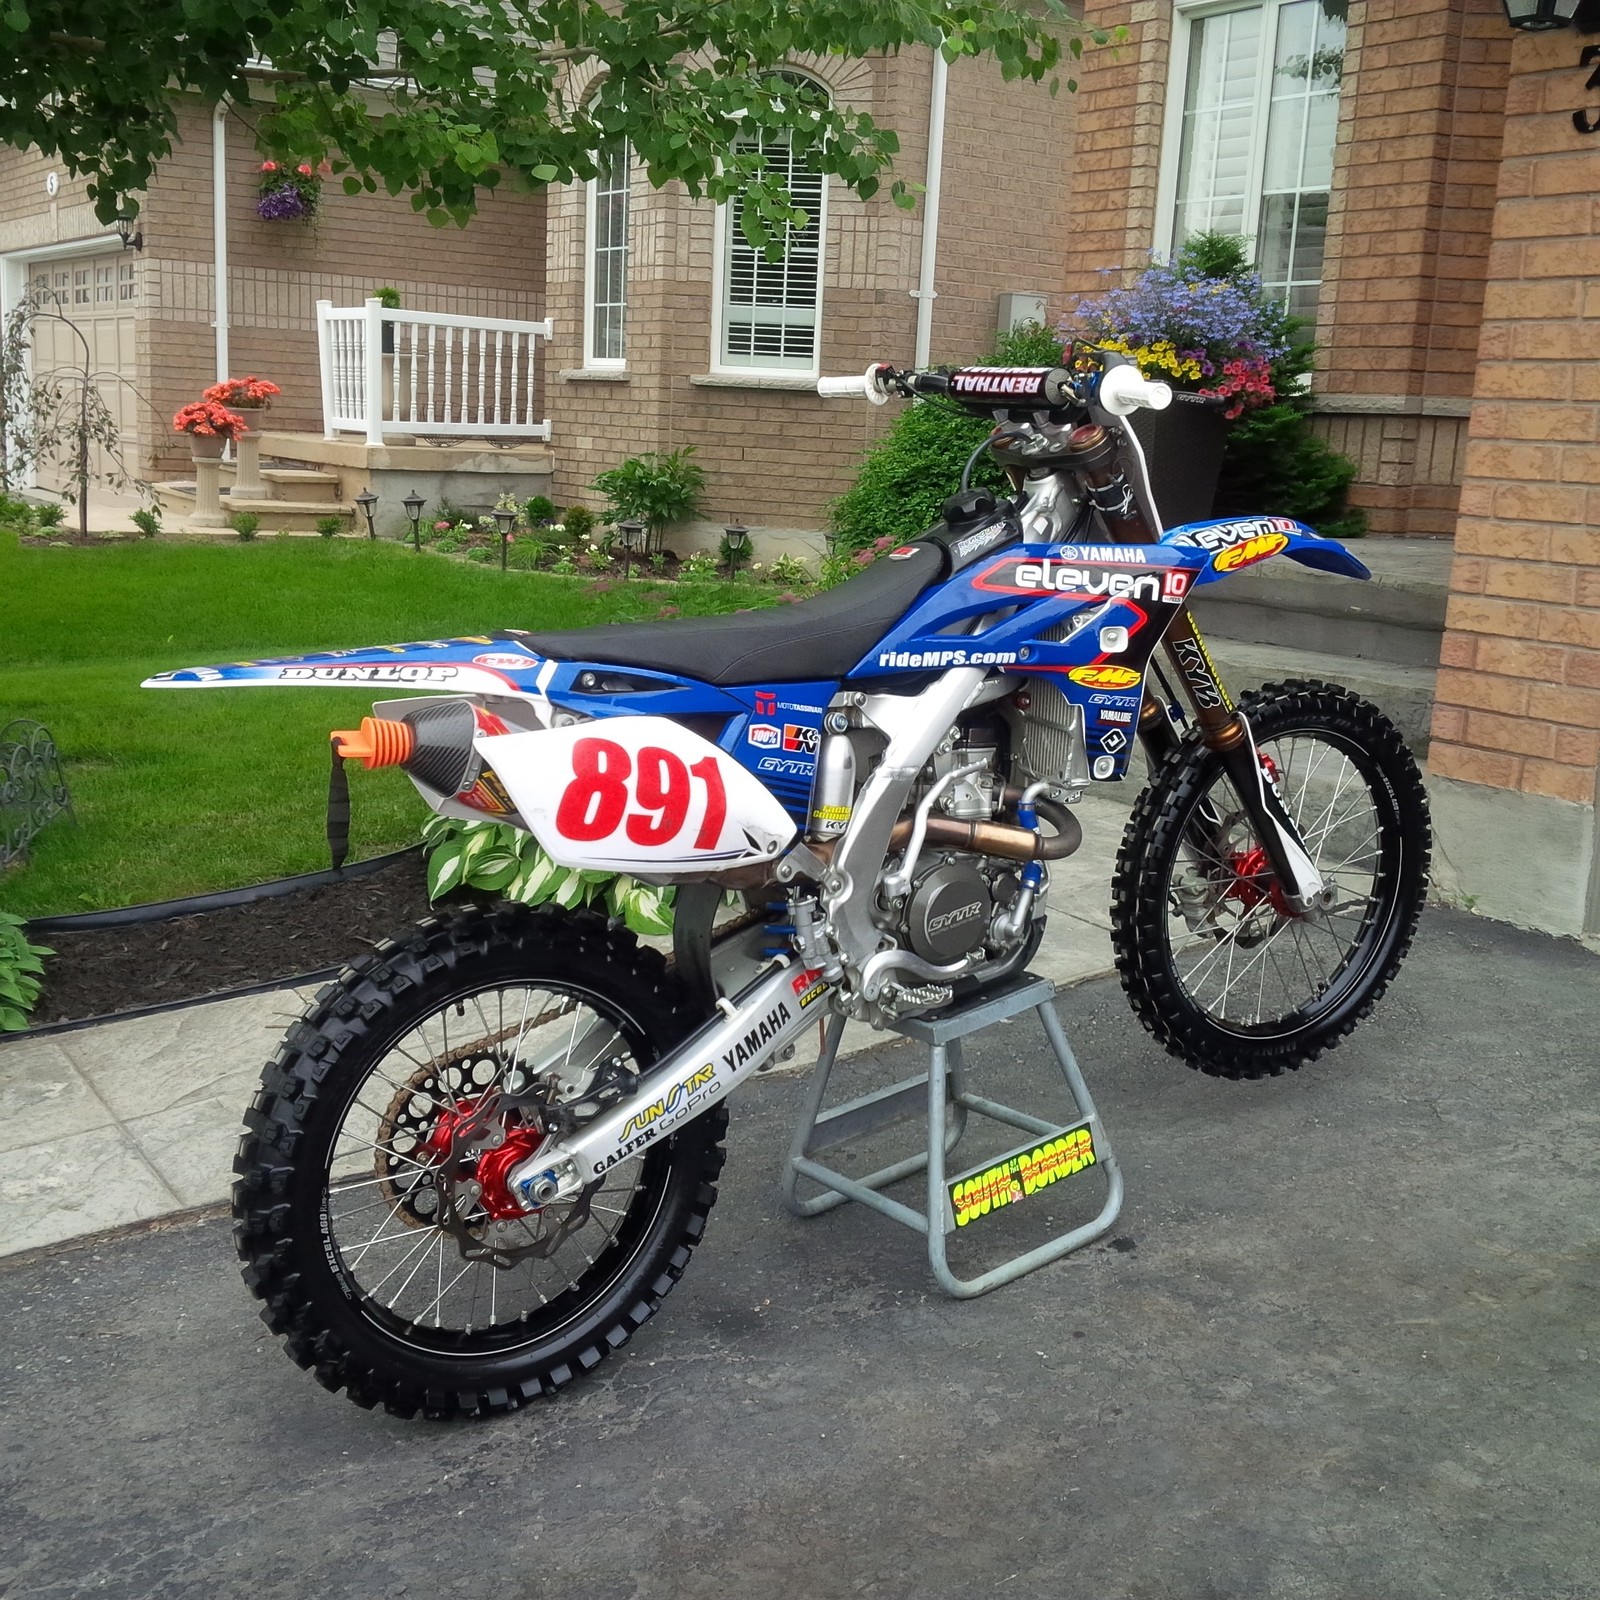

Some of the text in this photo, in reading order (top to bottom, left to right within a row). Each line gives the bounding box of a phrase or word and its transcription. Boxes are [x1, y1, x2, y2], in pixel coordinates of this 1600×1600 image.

[952, 375, 1042, 394] RENTHAL
[1080, 546, 1147, 564] YAMAHA
[1214, 533, 1288, 572] FMF
[1015, 558, 1188, 602] eleven 10
[278, 665, 459, 684] DUNLOP
[879, 649, 1017, 667] rideMPS.com
[1172, 637, 1222, 709] KYB
[1068, 668, 1142, 684] FMF
[1088, 693, 1141, 707] GYTR
[1100, 709, 1132, 723] YAMALUBE
[753, 729, 777, 744] 100%
[757, 756, 816, 777] GYTR
[555, 737, 727, 851] 891
[927, 901, 983, 933] GYTR
[721, 1001, 791, 1073] YAMAHA
[618, 1062, 717, 1144] SUNSTAR
[659, 1081, 721, 1131] GoPro
[592, 1127, 658, 1175] GALFER
[953, 1162, 1011, 1227] SOUTH
[1018, 1129, 1096, 1195] BORDER
[322, 1235, 340, 1274] EXCEL
